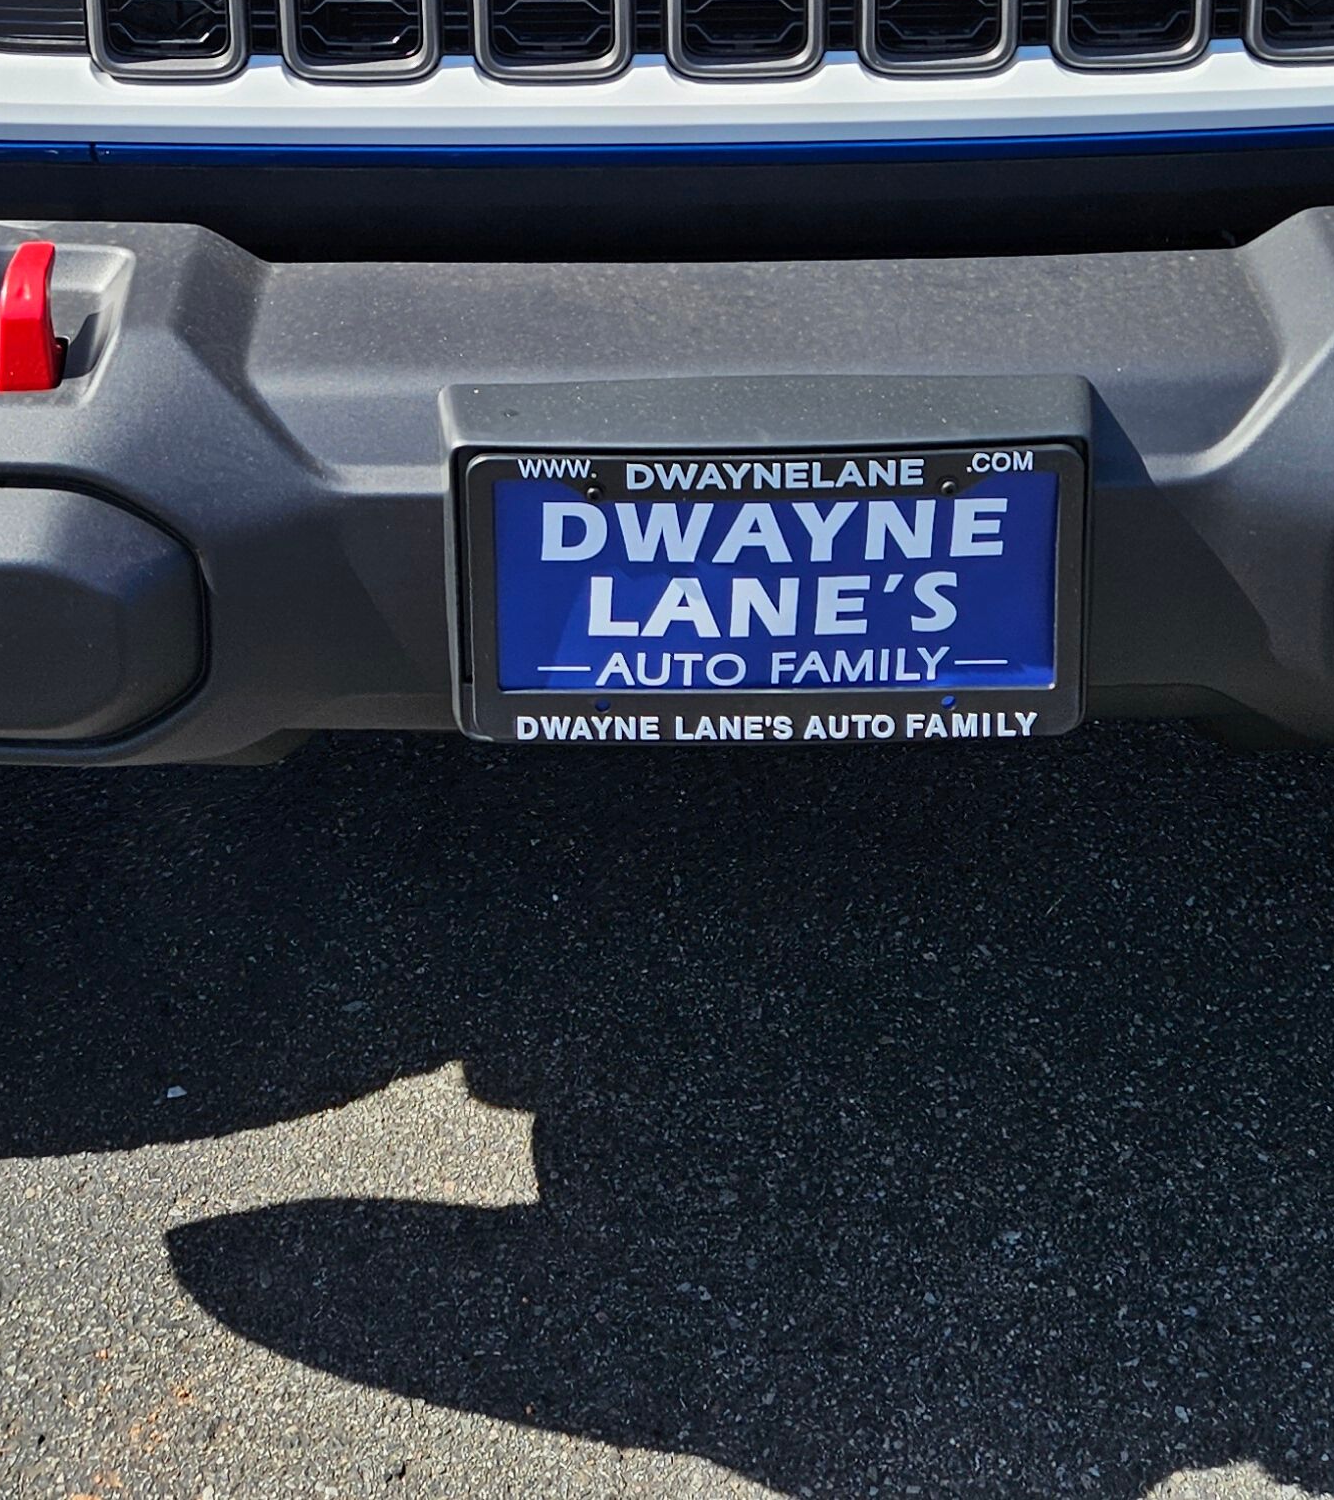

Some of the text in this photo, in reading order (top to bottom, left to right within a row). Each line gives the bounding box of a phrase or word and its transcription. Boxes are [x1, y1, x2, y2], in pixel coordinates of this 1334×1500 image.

[517, 450, 1034, 491] WWW. DWAYNELANE .COM
[540, 497, 1008, 562] DWAYNE
[588, 571, 958, 638] LANE'S
[595, 646, 951, 688] AUTO FAMILY
[516, 711, 1038, 741] DWAYNE LANE'S AUTO FAMILY
